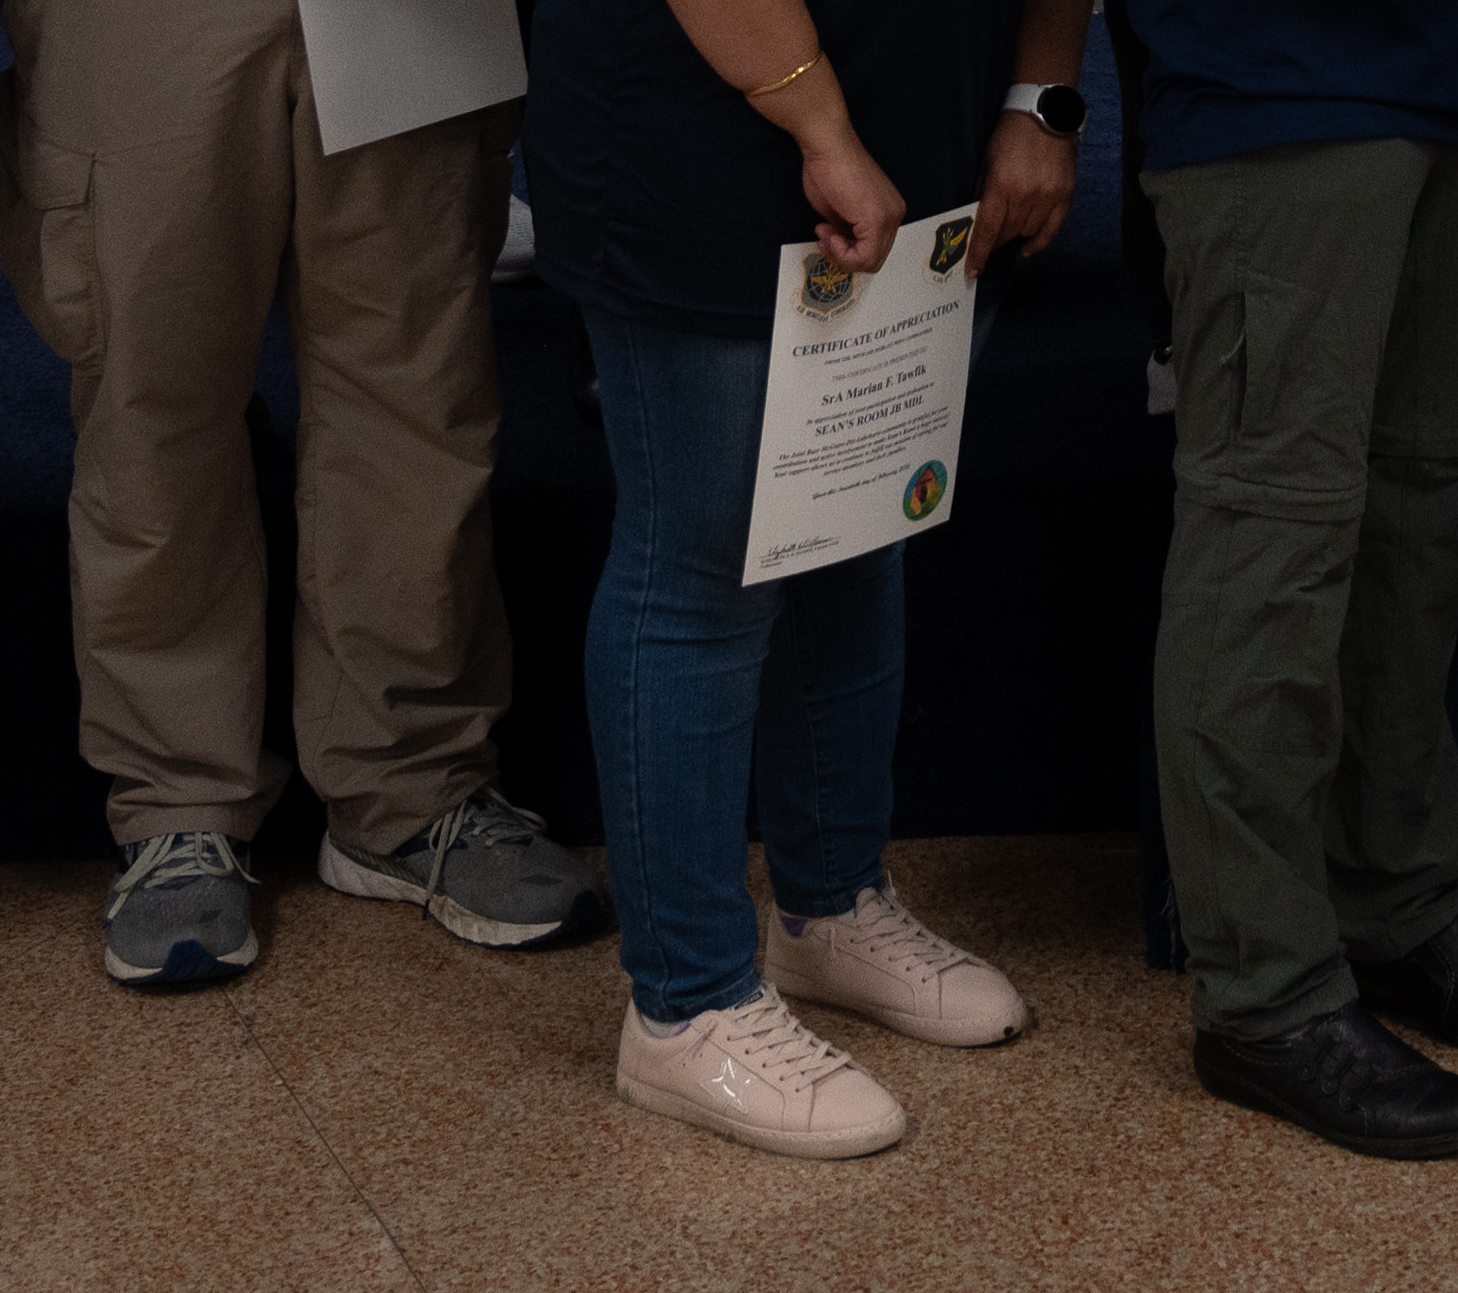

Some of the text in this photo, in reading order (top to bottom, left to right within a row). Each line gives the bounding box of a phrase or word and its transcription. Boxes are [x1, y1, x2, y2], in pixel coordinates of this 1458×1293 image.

[792, 332, 872, 358] CERTIFICATE
[874, 326, 888, 339] OF
[889, 299, 959, 334] APPRECIATION
[821, 363, 926, 406] SrA Marian F. Tawfik
[815, 394, 924, 437] SEAN'S ROOM JB MDL
